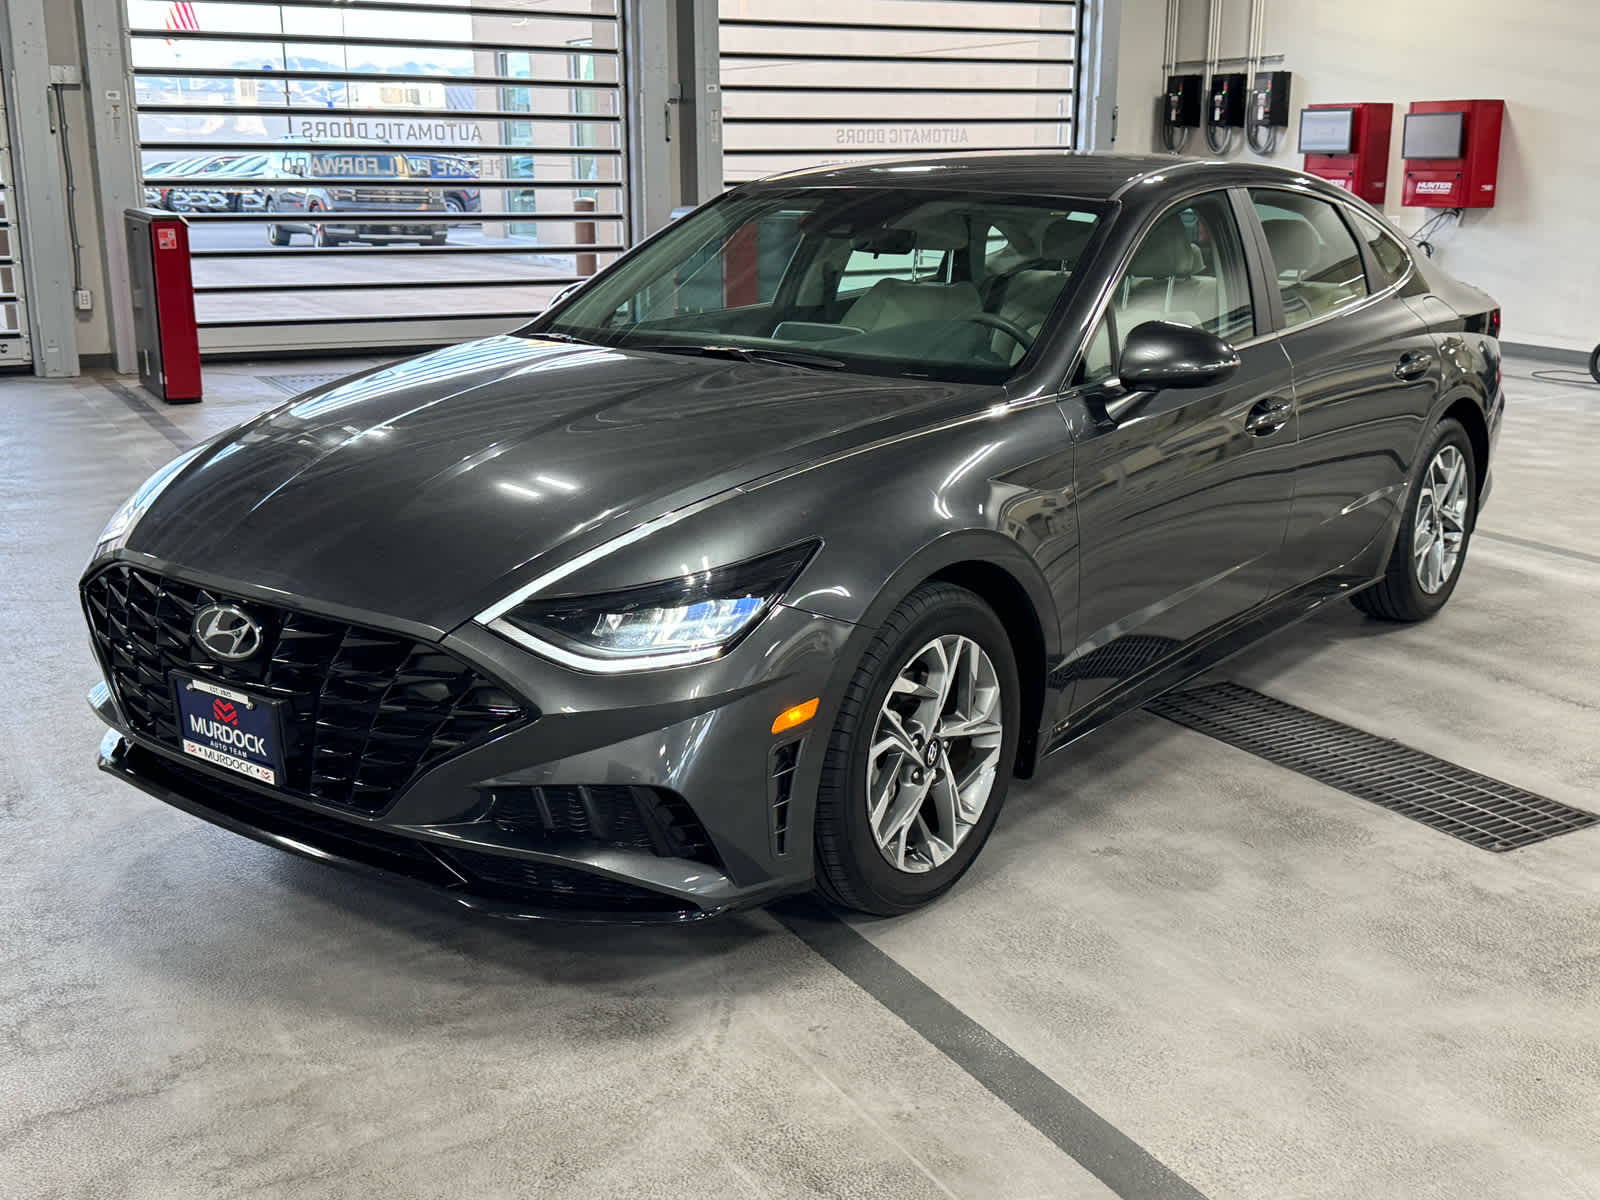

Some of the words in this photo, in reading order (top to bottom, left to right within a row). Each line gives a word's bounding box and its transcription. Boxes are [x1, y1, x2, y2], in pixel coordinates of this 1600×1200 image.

[189, 714, 267, 756] MURDOCK
[204, 748, 254, 775] MURDOCK
[210, 740, 227, 753] AUTO
[229, 746, 248, 759] TEAM
